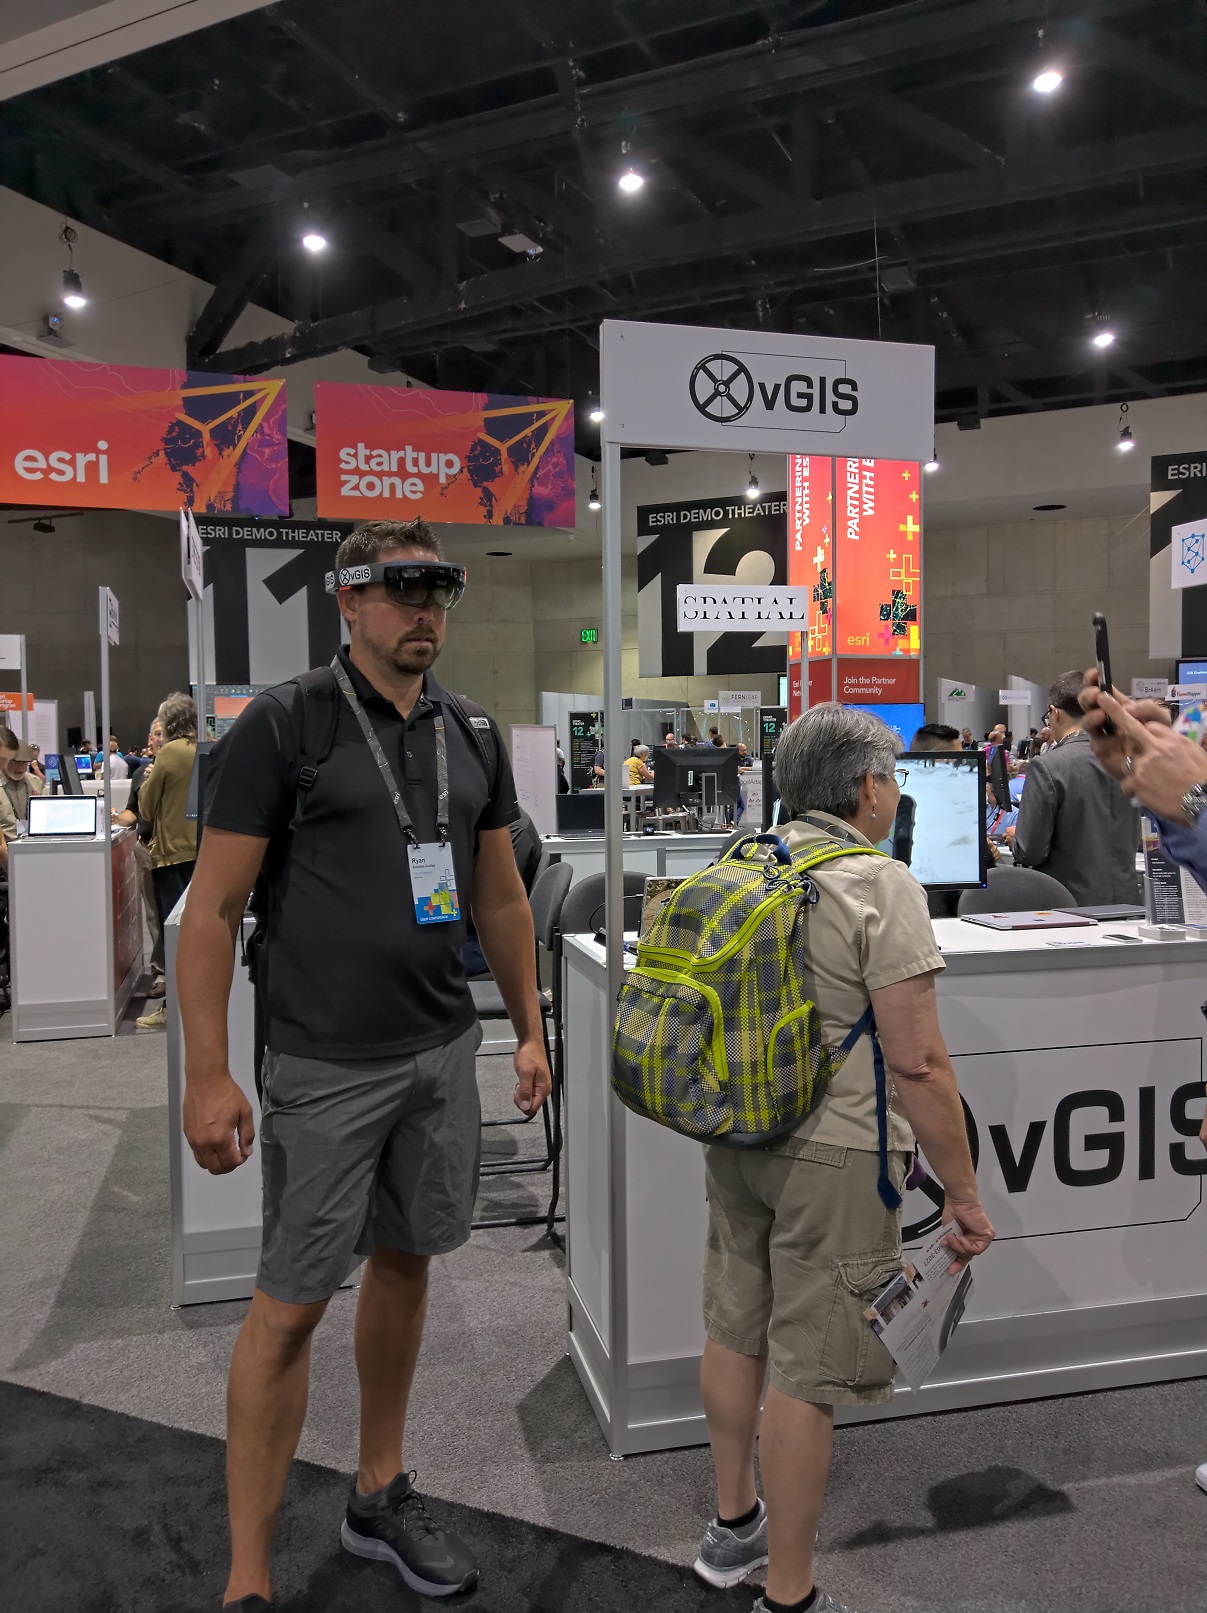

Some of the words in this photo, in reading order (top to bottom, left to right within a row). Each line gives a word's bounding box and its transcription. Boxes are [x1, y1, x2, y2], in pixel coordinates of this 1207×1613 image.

[757, 373, 859, 416] vGIS
[14, 440, 109, 484] esri
[339, 442, 461, 483] startup
[1168, 463, 1207, 480] ESRI
[340, 474, 425, 499] zone
[862, 471, 875, 516] WITH
[649, 512, 677, 527] ESRI
[681, 507, 724, 523] DEMO
[726, 502, 788, 519] THEATER
[199, 525, 228, 539] ESRI
[232, 526, 278, 540] DEMO
[280, 529, 341, 542] THEATER
[684, 596, 805, 620] SPATIAL
[581, 629, 597, 642] EXIT
[847, 633, 870, 646] esri
[843, 677, 858, 685] Join
[859, 677, 870, 685] the
[872, 677, 896, 685] Partner
[844, 686, 883, 696] Community
[572, 726, 584, 736] 12
[763, 722, 776, 733] 12
